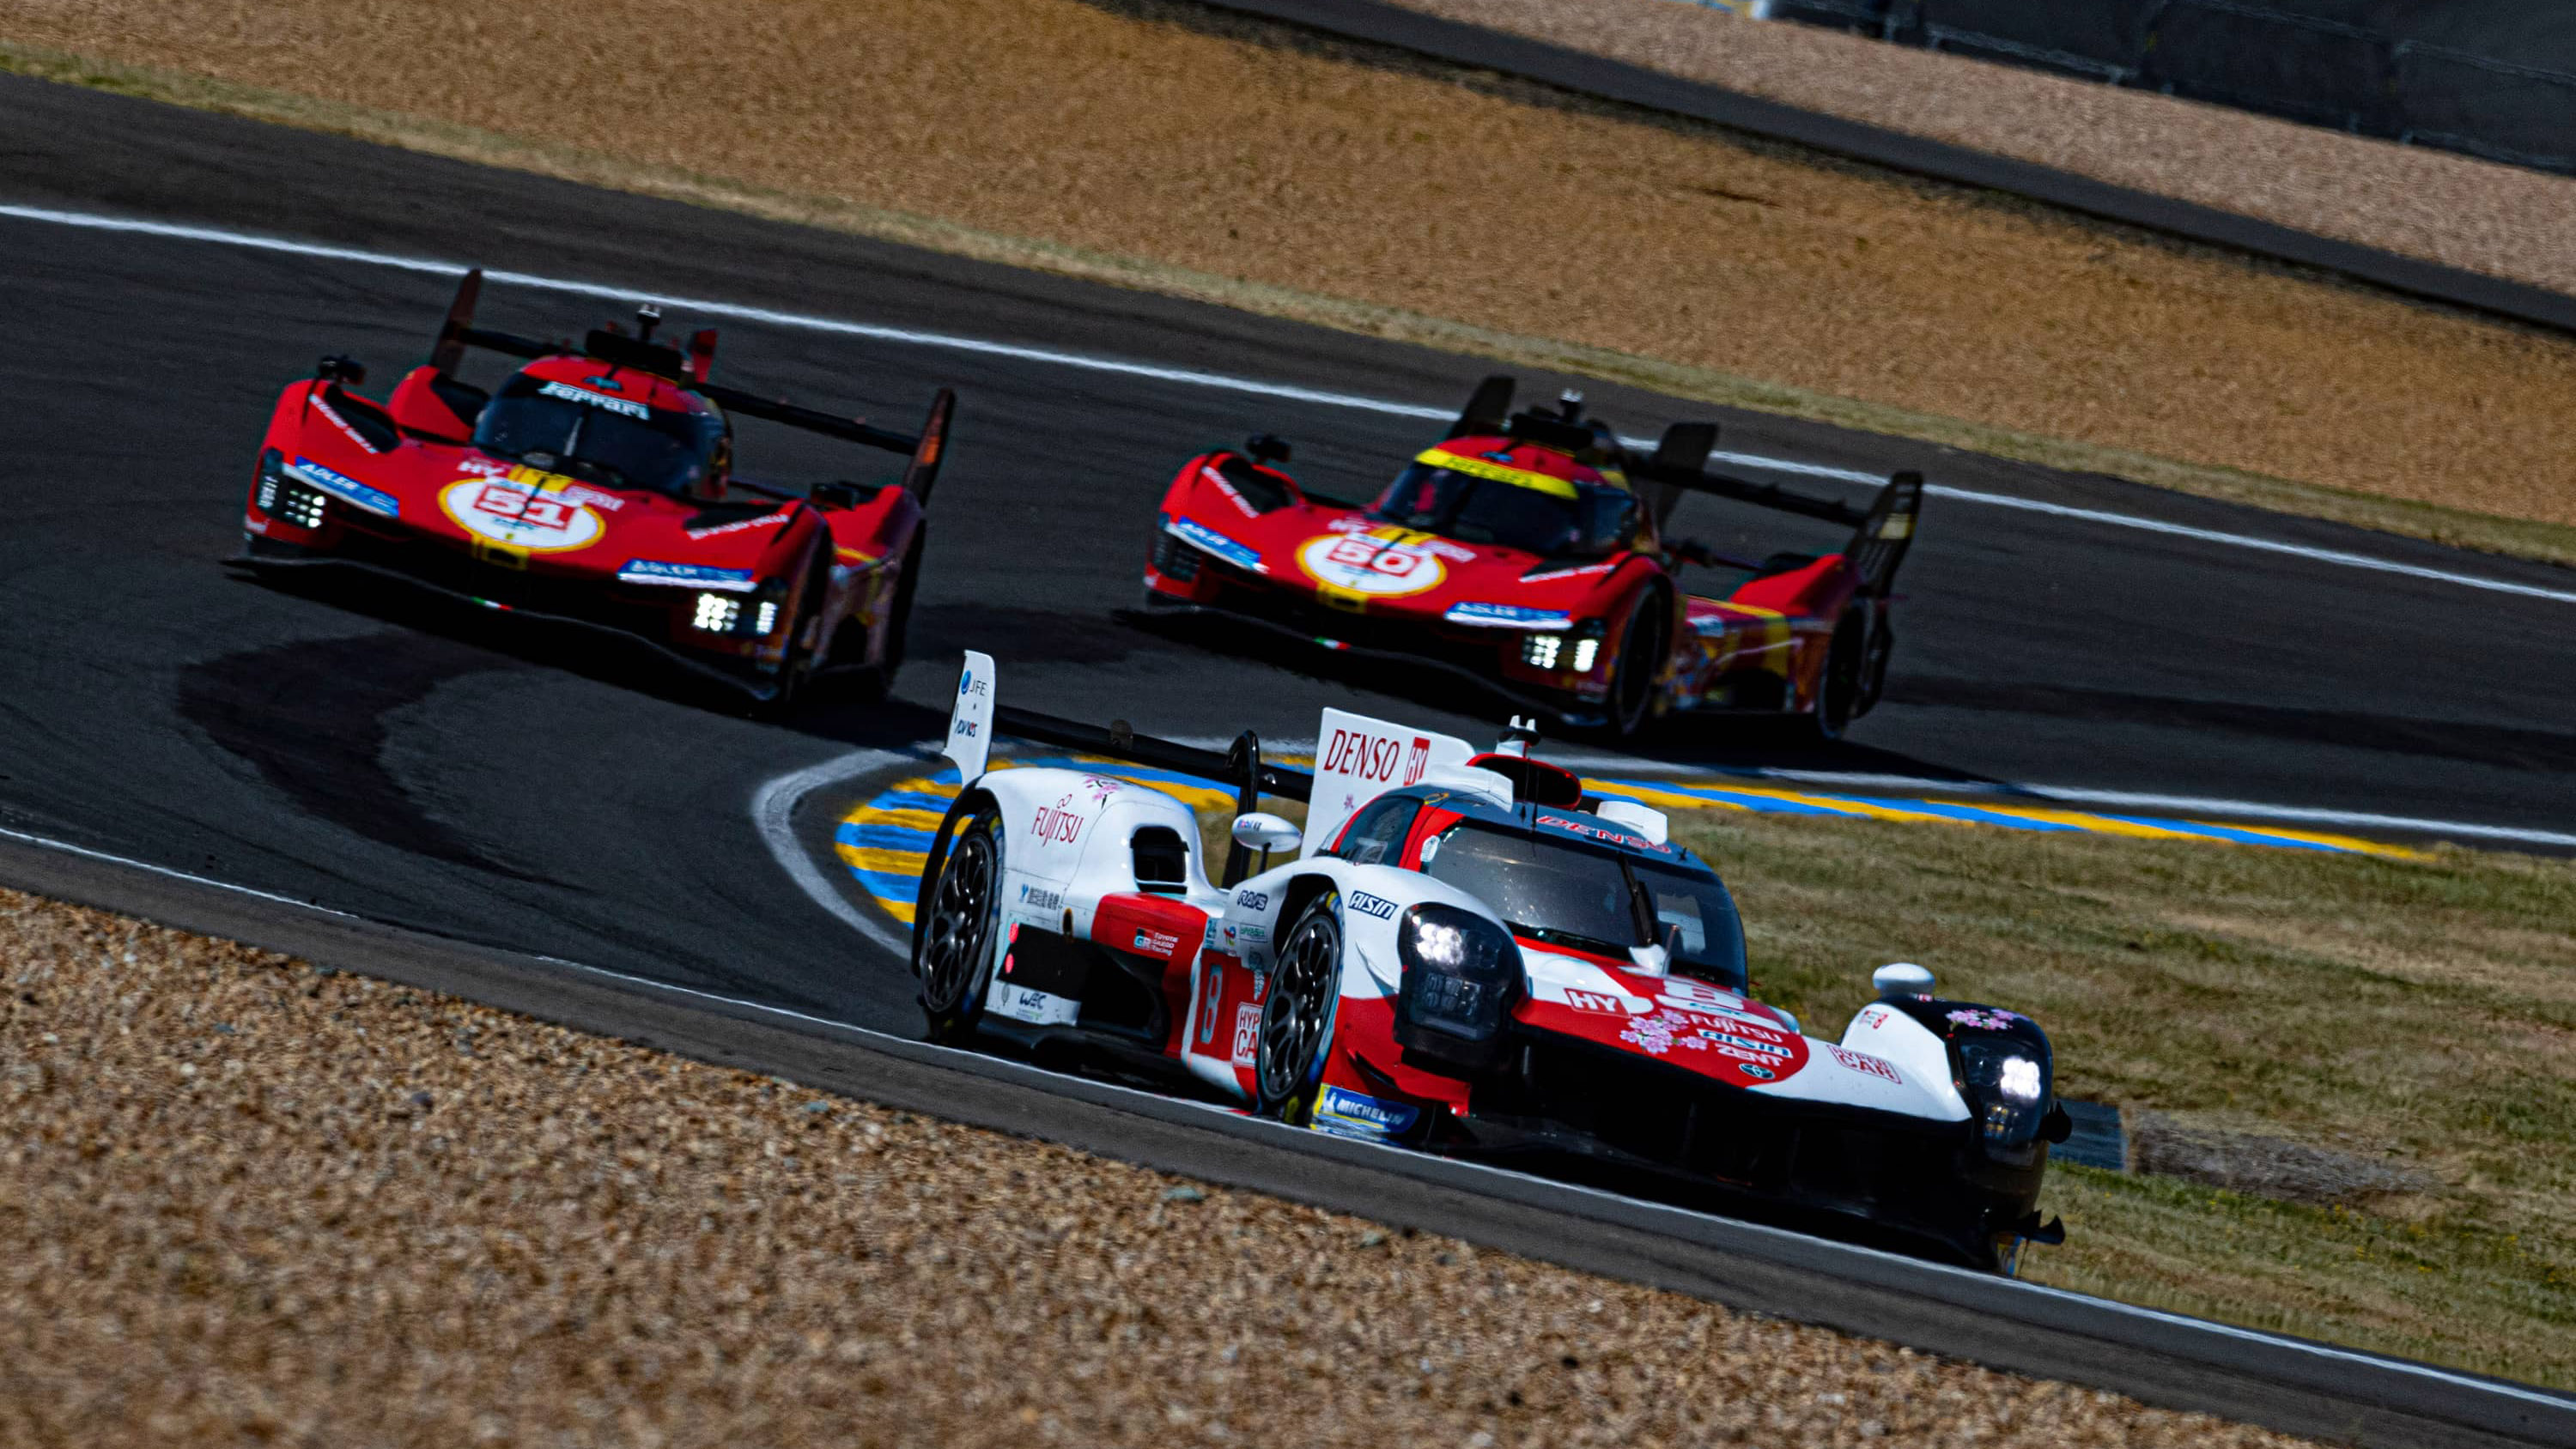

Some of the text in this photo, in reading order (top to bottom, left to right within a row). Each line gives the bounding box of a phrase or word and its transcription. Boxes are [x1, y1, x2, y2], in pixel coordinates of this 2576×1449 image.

[538, 381, 651, 421] Ferrari
[474, 486, 574, 530] 51
[1331, 539, 1419, 578] 50
[969, 680, 987, 697] JFE
[1323, 728, 1400, 783] DENSO
[1030, 806, 1084, 848] FUJITSU
[1237, 889, 1268, 912] RAYS
[1348, 892, 1396, 919] AISIN
[1018, 991, 1047, 1010] WEC
[1200, 964, 1224, 1045] 8
[1569, 990, 1619, 1013] HY
[1690, 1014, 1783, 1043] FUJITSU
[1697, 1028, 1794, 1058] AISIN
[1715, 1043, 1784, 1066] ZENT
[1336, 1098, 1405, 1125] MICHELIN
